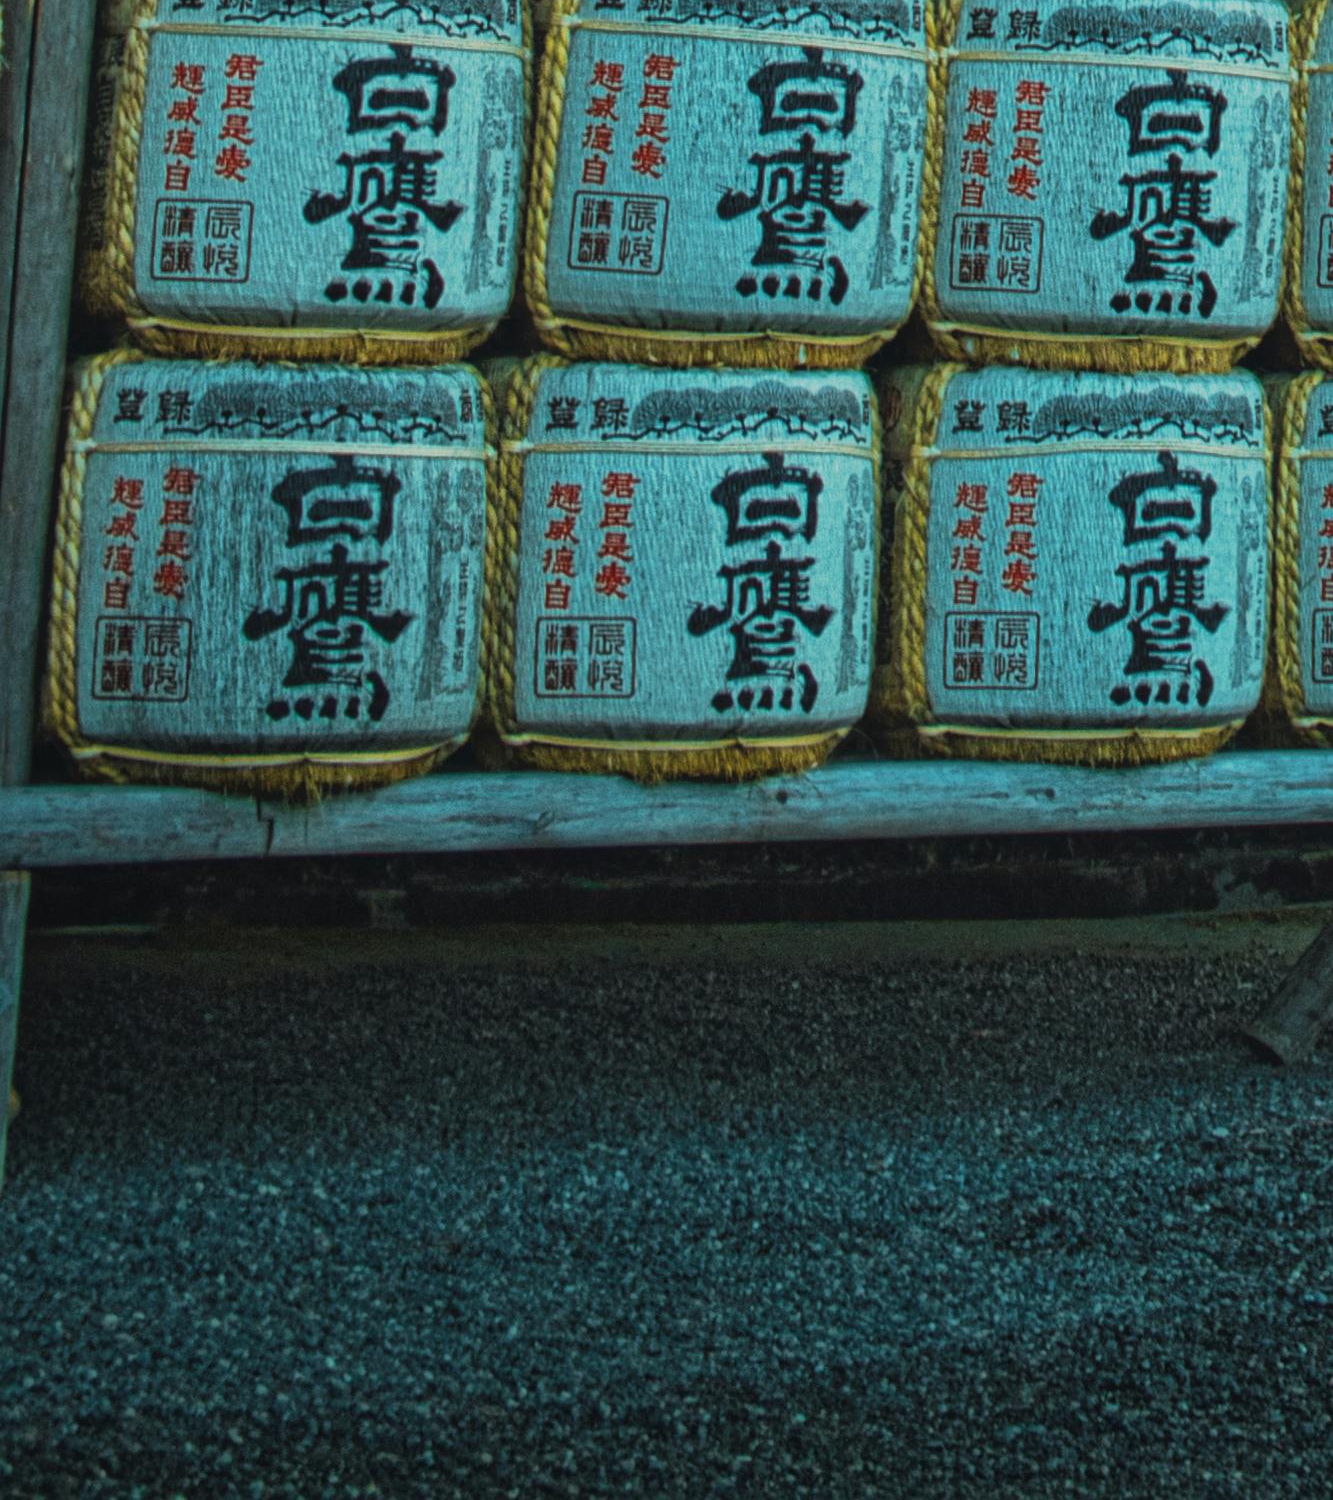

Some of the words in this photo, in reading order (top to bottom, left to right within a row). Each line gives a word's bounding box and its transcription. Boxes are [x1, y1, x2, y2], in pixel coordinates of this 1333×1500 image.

[304, 43, 463, 310] 白鷹
[717, 46, 868, 305] 白鷹
[1090, 69, 1235, 318] 白鷹
[243, 454, 412, 721] 白鷹
[687, 452, 833, 713] 白鷹
[1088, 451, 1227, 707] 白鷹
